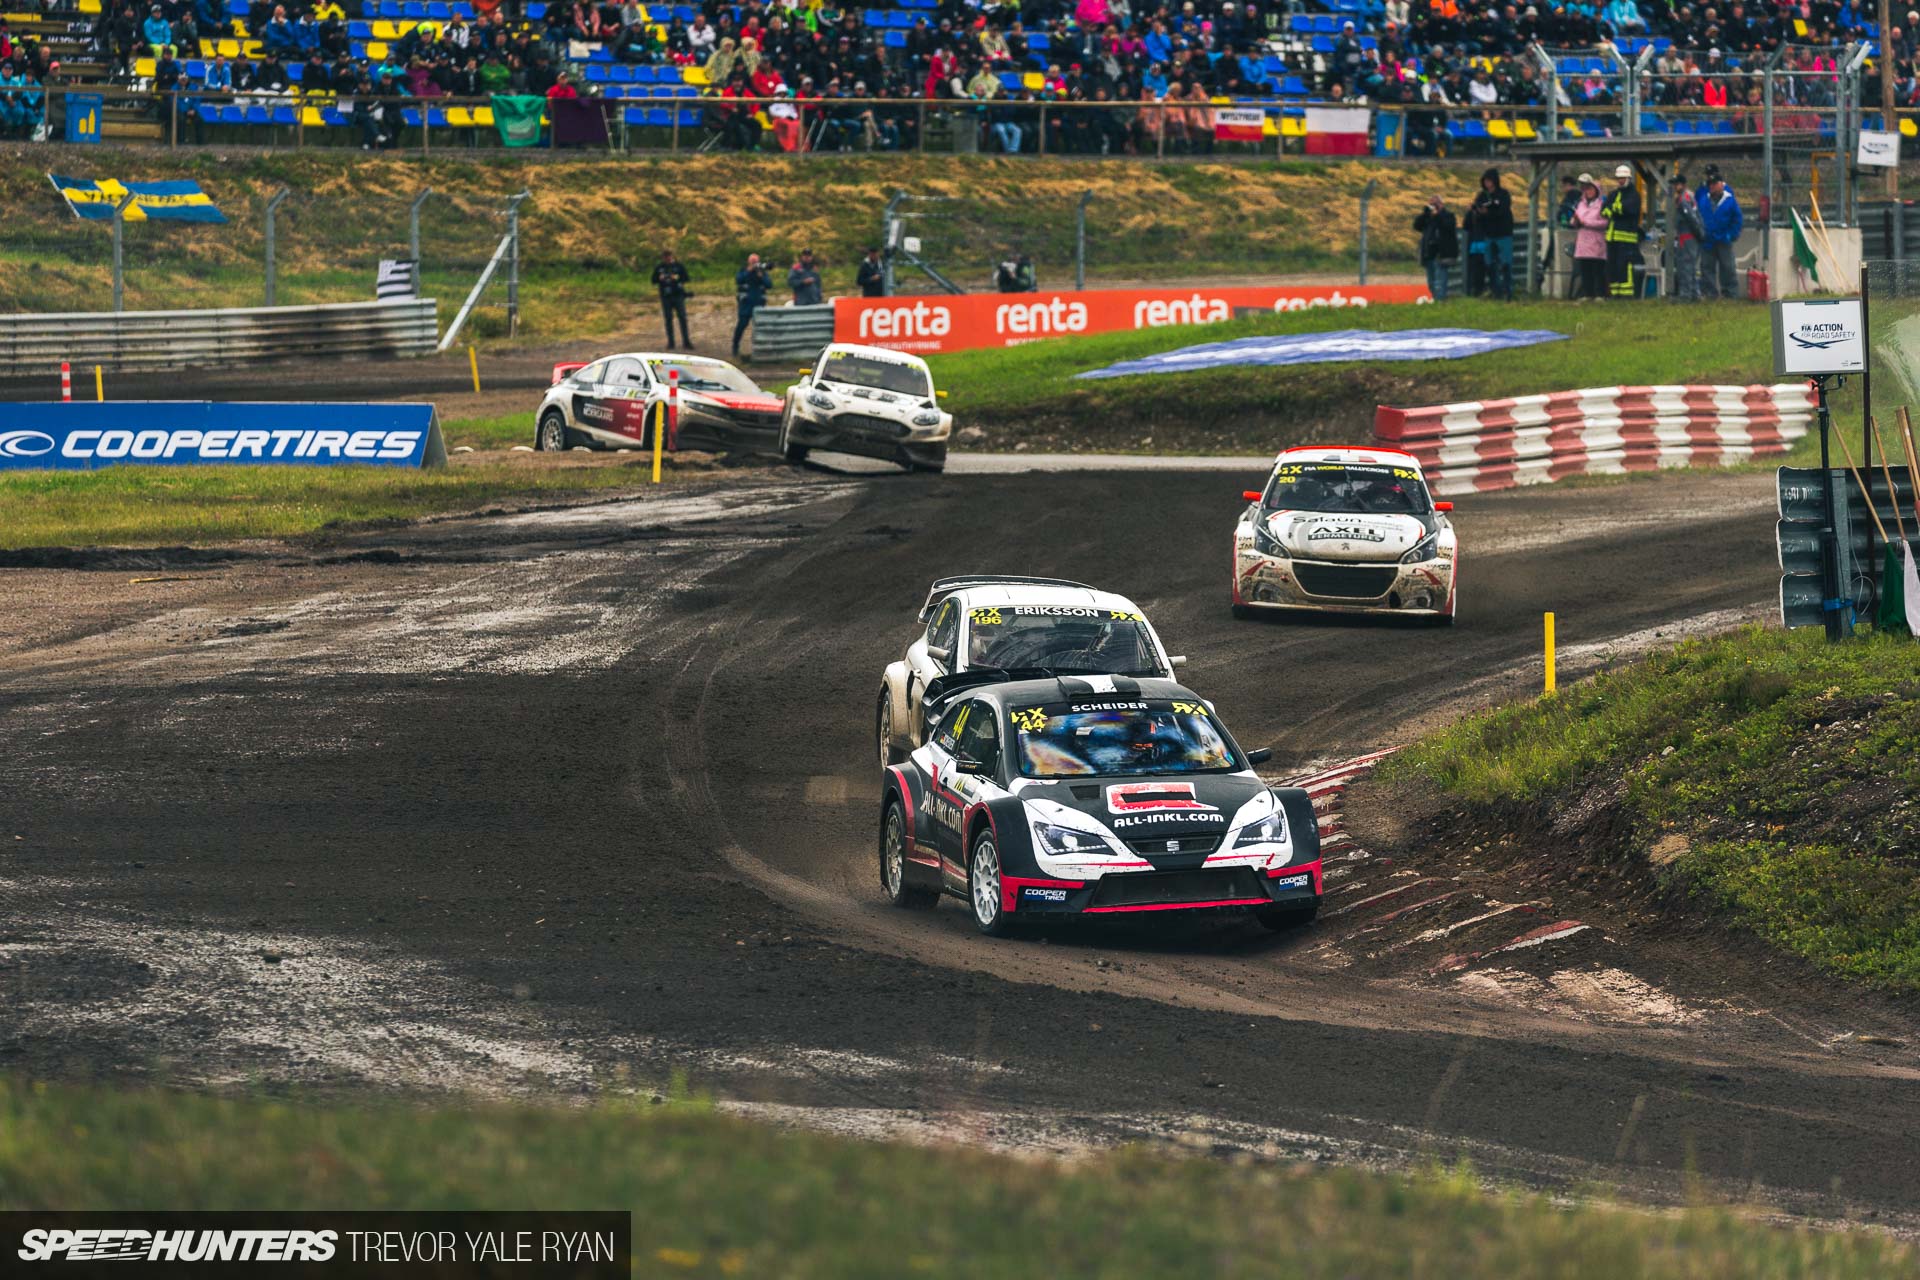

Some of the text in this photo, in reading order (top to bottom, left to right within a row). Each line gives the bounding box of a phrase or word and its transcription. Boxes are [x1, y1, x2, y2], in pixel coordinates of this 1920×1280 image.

[996, 297, 1088, 334] renta
[1134, 294, 1228, 329] renta
[859, 301, 951, 338] renta
[1813, 323, 1843, 332] ACTION
[1345, 466, 1389, 474] RALLYCROSS
[1014, 606, 1099, 617] ERIKSSON
[974, 616, 1002, 624] 196
[1071, 702, 1149, 712] SCHEIDER
[1021, 718, 1046, 731] 44
[1279, 875, 1308, 885] COOPER
[1025, 889, 1067, 897] COOPER
